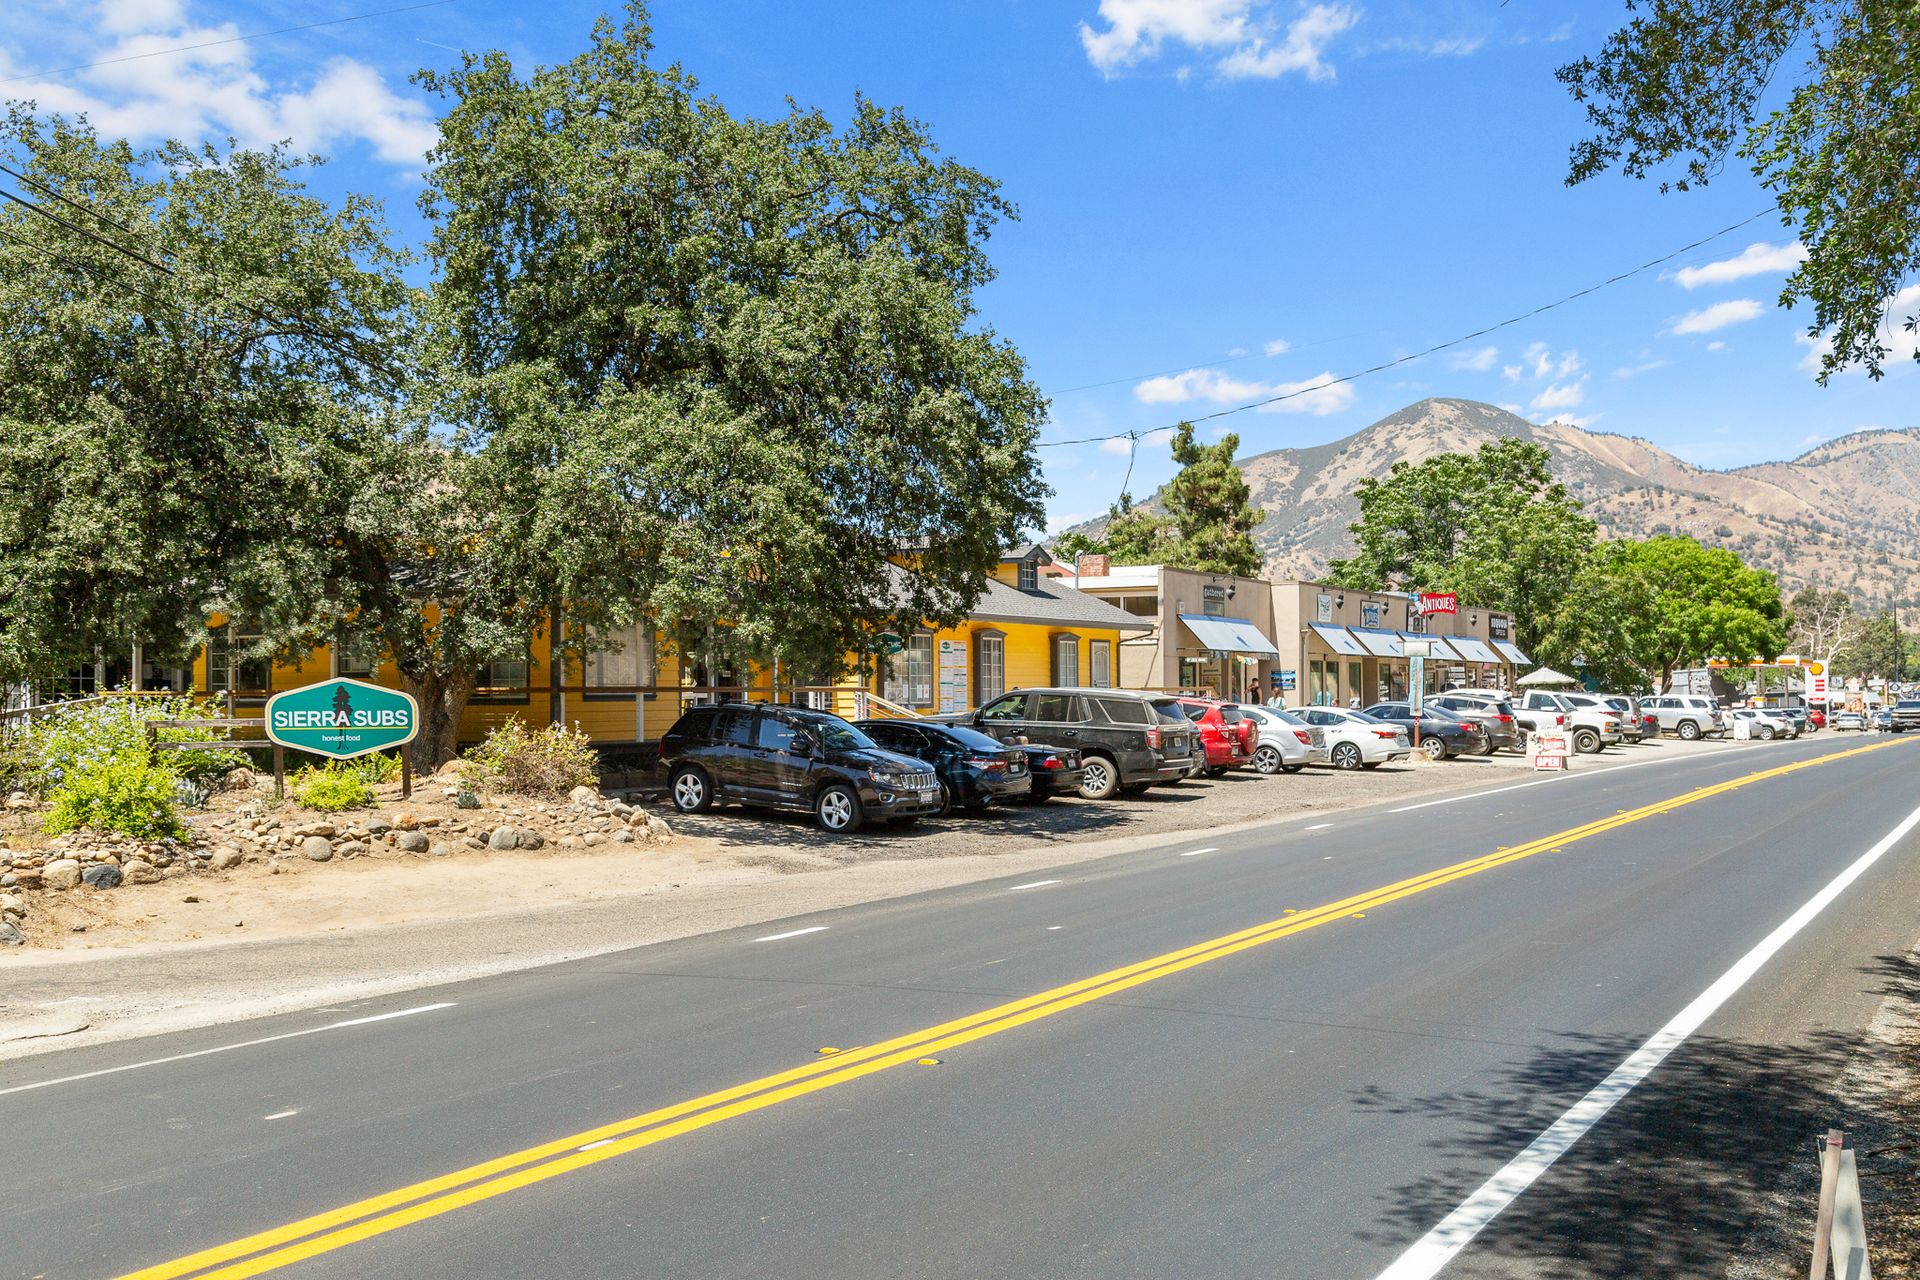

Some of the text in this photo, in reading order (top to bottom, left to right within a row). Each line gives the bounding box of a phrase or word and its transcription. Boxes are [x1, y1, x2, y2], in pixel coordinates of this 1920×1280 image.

[1423, 595, 1455, 612] ANTIQUES
[274, 710, 408, 727] SIERRA SUBS
[322, 734, 361, 742] honest food
[1537, 756, 1560, 766] OPEN
